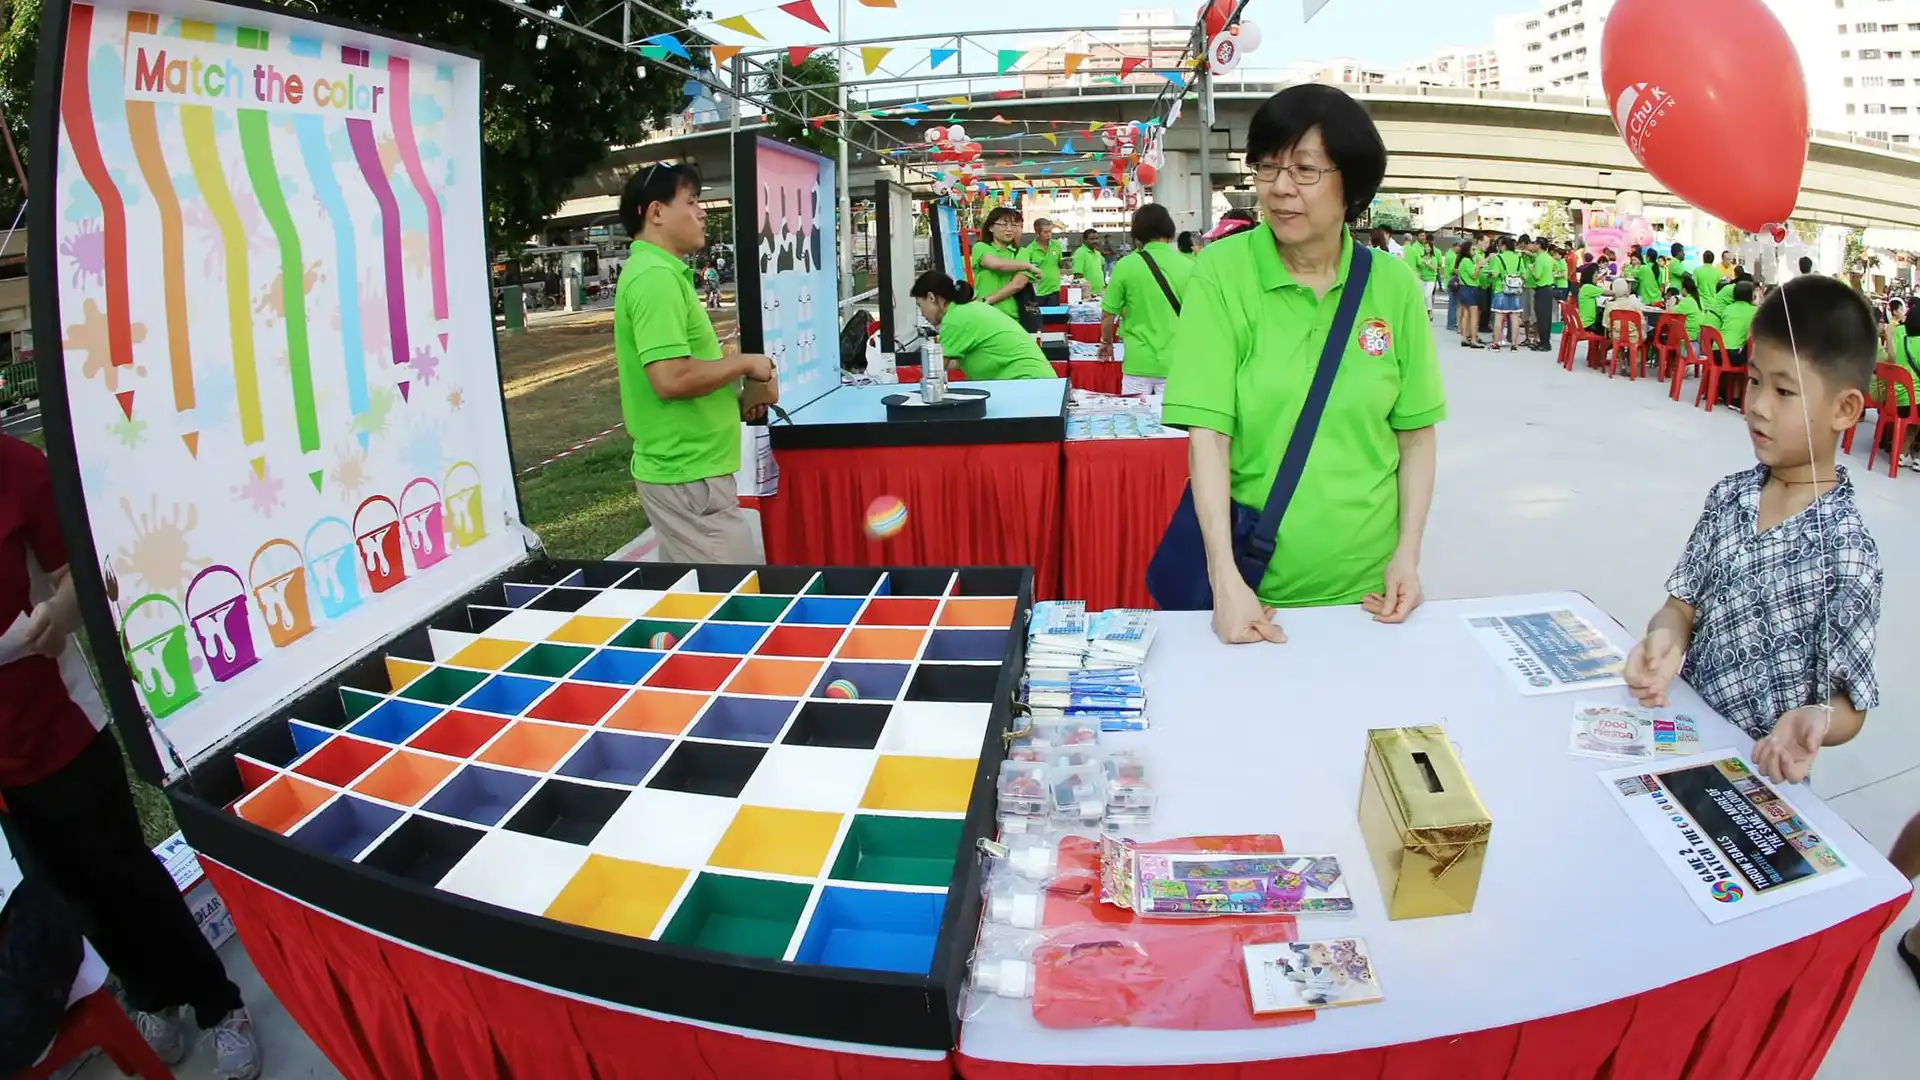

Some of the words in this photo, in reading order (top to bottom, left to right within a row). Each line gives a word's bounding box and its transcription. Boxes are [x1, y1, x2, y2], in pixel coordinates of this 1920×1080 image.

[135, 47, 243, 100] Match
[253, 64, 304, 104] the
[313, 73, 384, 113] color
[1630, 100, 1652, 133] Chu
[1365, 328, 1384, 339] SG
[1367, 339, 1384, 351] 50
[1705, 788, 1721, 797] OF
[1722, 789, 1753, 815] COLOUR
[1651, 791, 1689, 828] COLOUR
[1713, 795, 1739, 815] MORE
[1731, 814, 1748, 825] OR
[1741, 823, 1754, 831] 2
[1746, 813, 1772, 834] SAME
[1681, 829, 1704, 847] THE
[1717, 835, 1744, 859] BALLS
[1745, 830, 1777, 855] MATCH
[1764, 832, 1785, 850] THE
[1679, 848, 1694, 856] 2
[1687, 857, 1716, 882] GAME
[1697, 848, 1732, 879] MATCH
[1740, 863, 1770, 889] THROW
